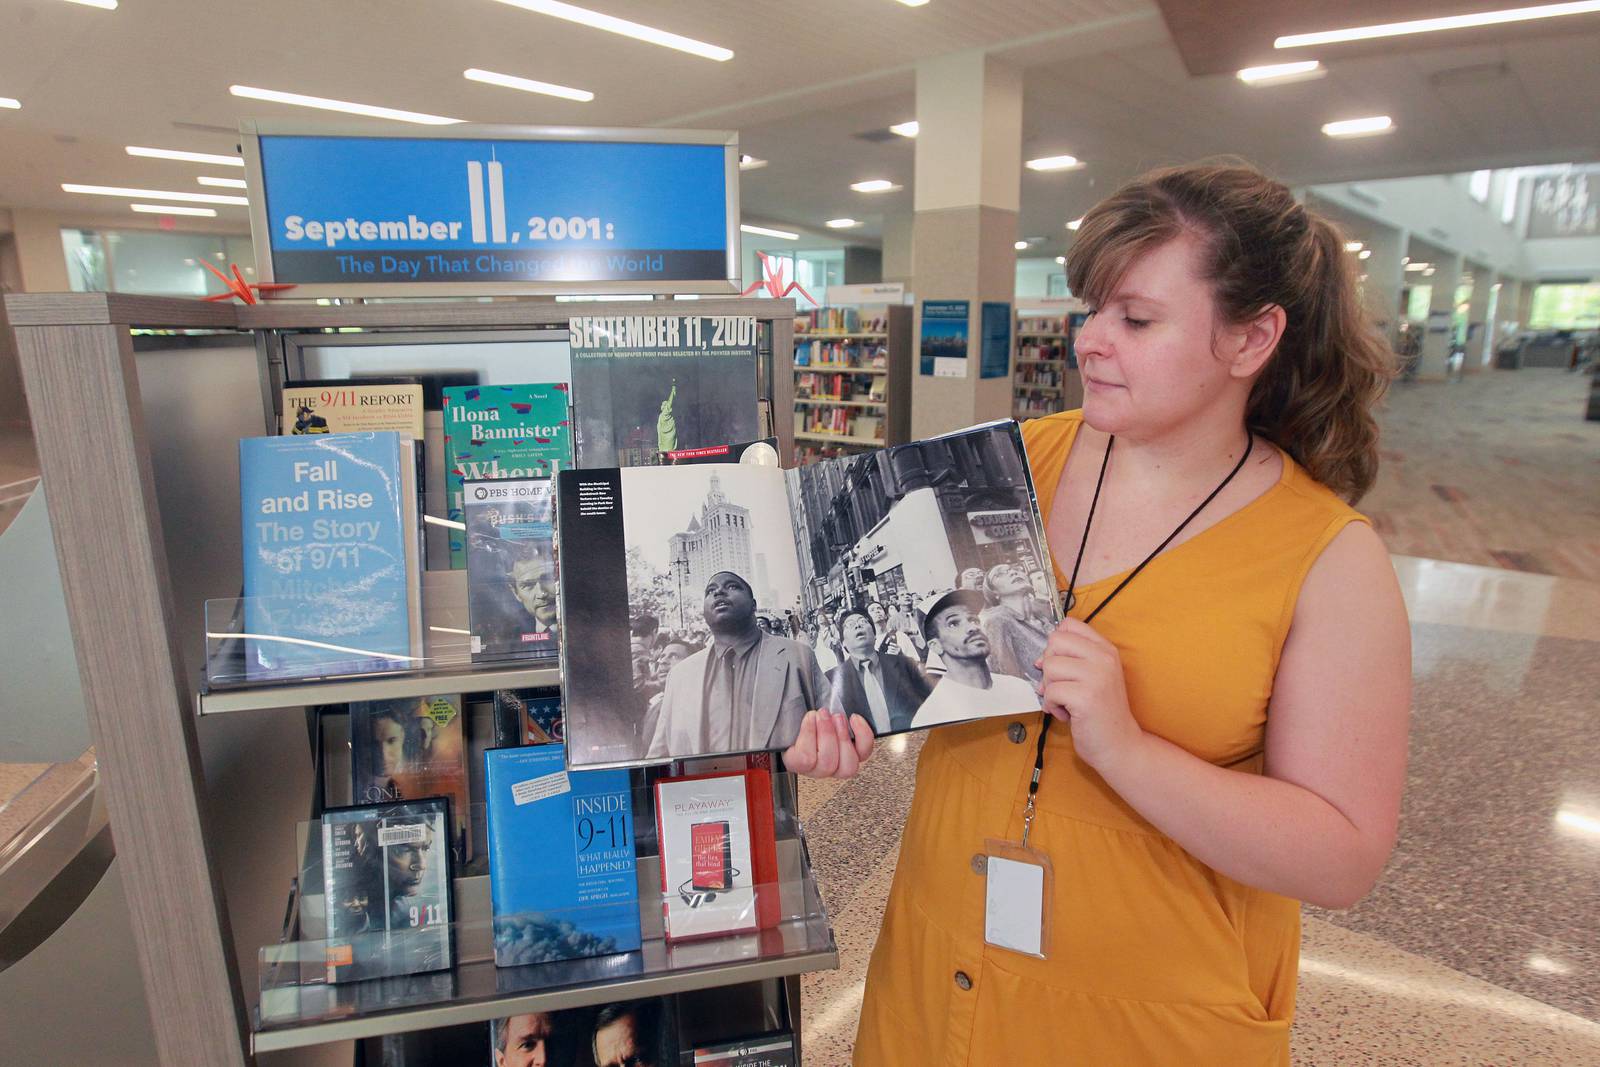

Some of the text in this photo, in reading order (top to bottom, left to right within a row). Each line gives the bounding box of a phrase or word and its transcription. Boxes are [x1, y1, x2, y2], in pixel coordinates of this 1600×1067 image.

[285, 215, 462, 247] September
[527, 216, 615, 241] 2001:
[337, 256, 375, 273] The
[382, 256, 420, 278] Day
[426, 256, 470, 273] That
[475, 254, 565, 276] Changed
[606, 254, 664, 272] World
[569, 316, 756, 350] SEPTEMBER 11, 2001
[288, 391, 414, 408] THE 9/11 REPORT
[452, 406, 500, 422] Ilona
[471, 422, 561, 440] Bannister
[294, 460, 338, 483] Fall
[457, 460, 543, 479] When
[261, 488, 374, 514] and Rise
[489, 488, 508, 498] PBS
[511, 487, 542, 497] HOME
[256, 518, 381, 543] The Story
[278, 547, 361, 574] of 9/11
[366, 786, 403, 801] ONE
[576, 794, 627, 815] INSIDE
[674, 799, 731, 813] PLAYAWAY
[578, 814, 628, 853] 9-11
[579, 849, 630, 862] WHAT REALLY
[580, 861, 631, 875] HAPPENED
[409, 902, 441, 928] 9/11
